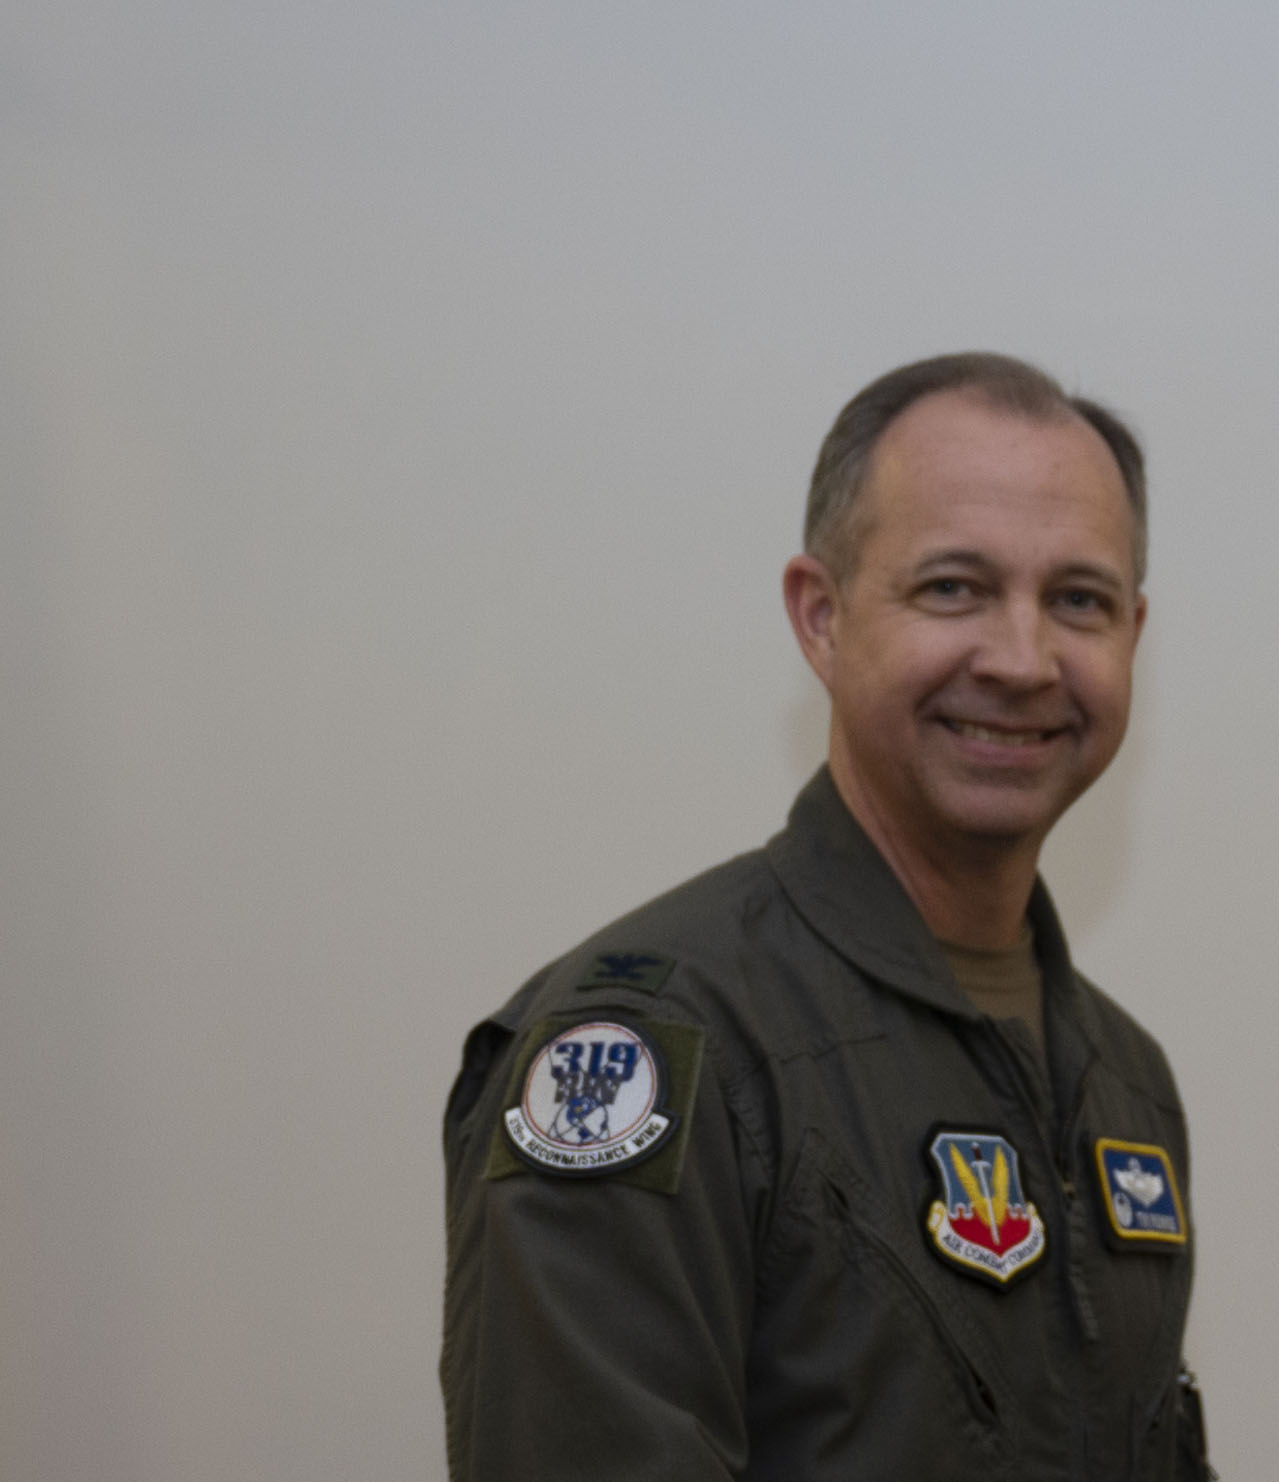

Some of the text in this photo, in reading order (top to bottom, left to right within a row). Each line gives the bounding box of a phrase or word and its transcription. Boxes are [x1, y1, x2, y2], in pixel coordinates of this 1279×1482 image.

[552, 1042, 636, 1082] 319
[527, 1141, 629, 1166] RECONNAISSANCE
[632, 1123, 662, 1147] WING
[943, 1233, 963, 1251] AIR
[964, 1245, 1008, 1273] COMBAT
